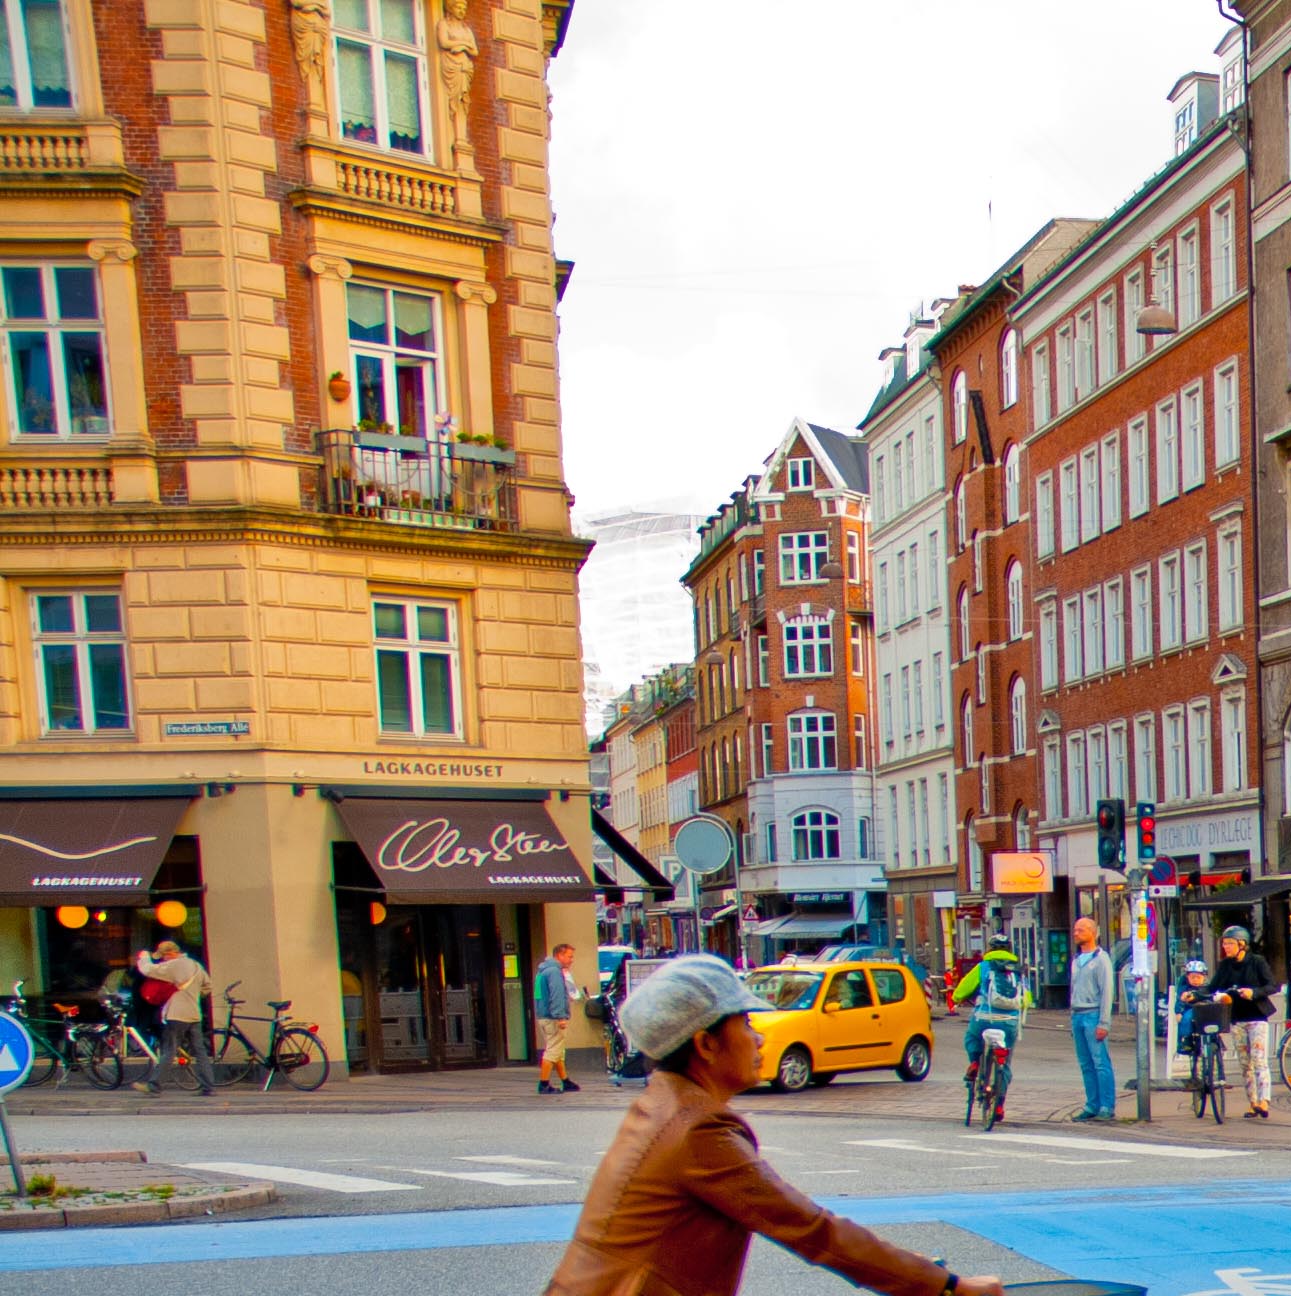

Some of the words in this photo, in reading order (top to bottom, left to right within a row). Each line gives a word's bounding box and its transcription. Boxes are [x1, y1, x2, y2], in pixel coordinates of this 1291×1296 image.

[167, 723, 228, 734] Frederiksberg
[363, 761, 503, 777] LAGKAGEHUSET
[1208, 817, 1252, 846] DYRLÆGE
[32, 877, 143, 887] LAGKAGEHUSET
[488, 876, 581, 885] LAGKAGEHUSET
